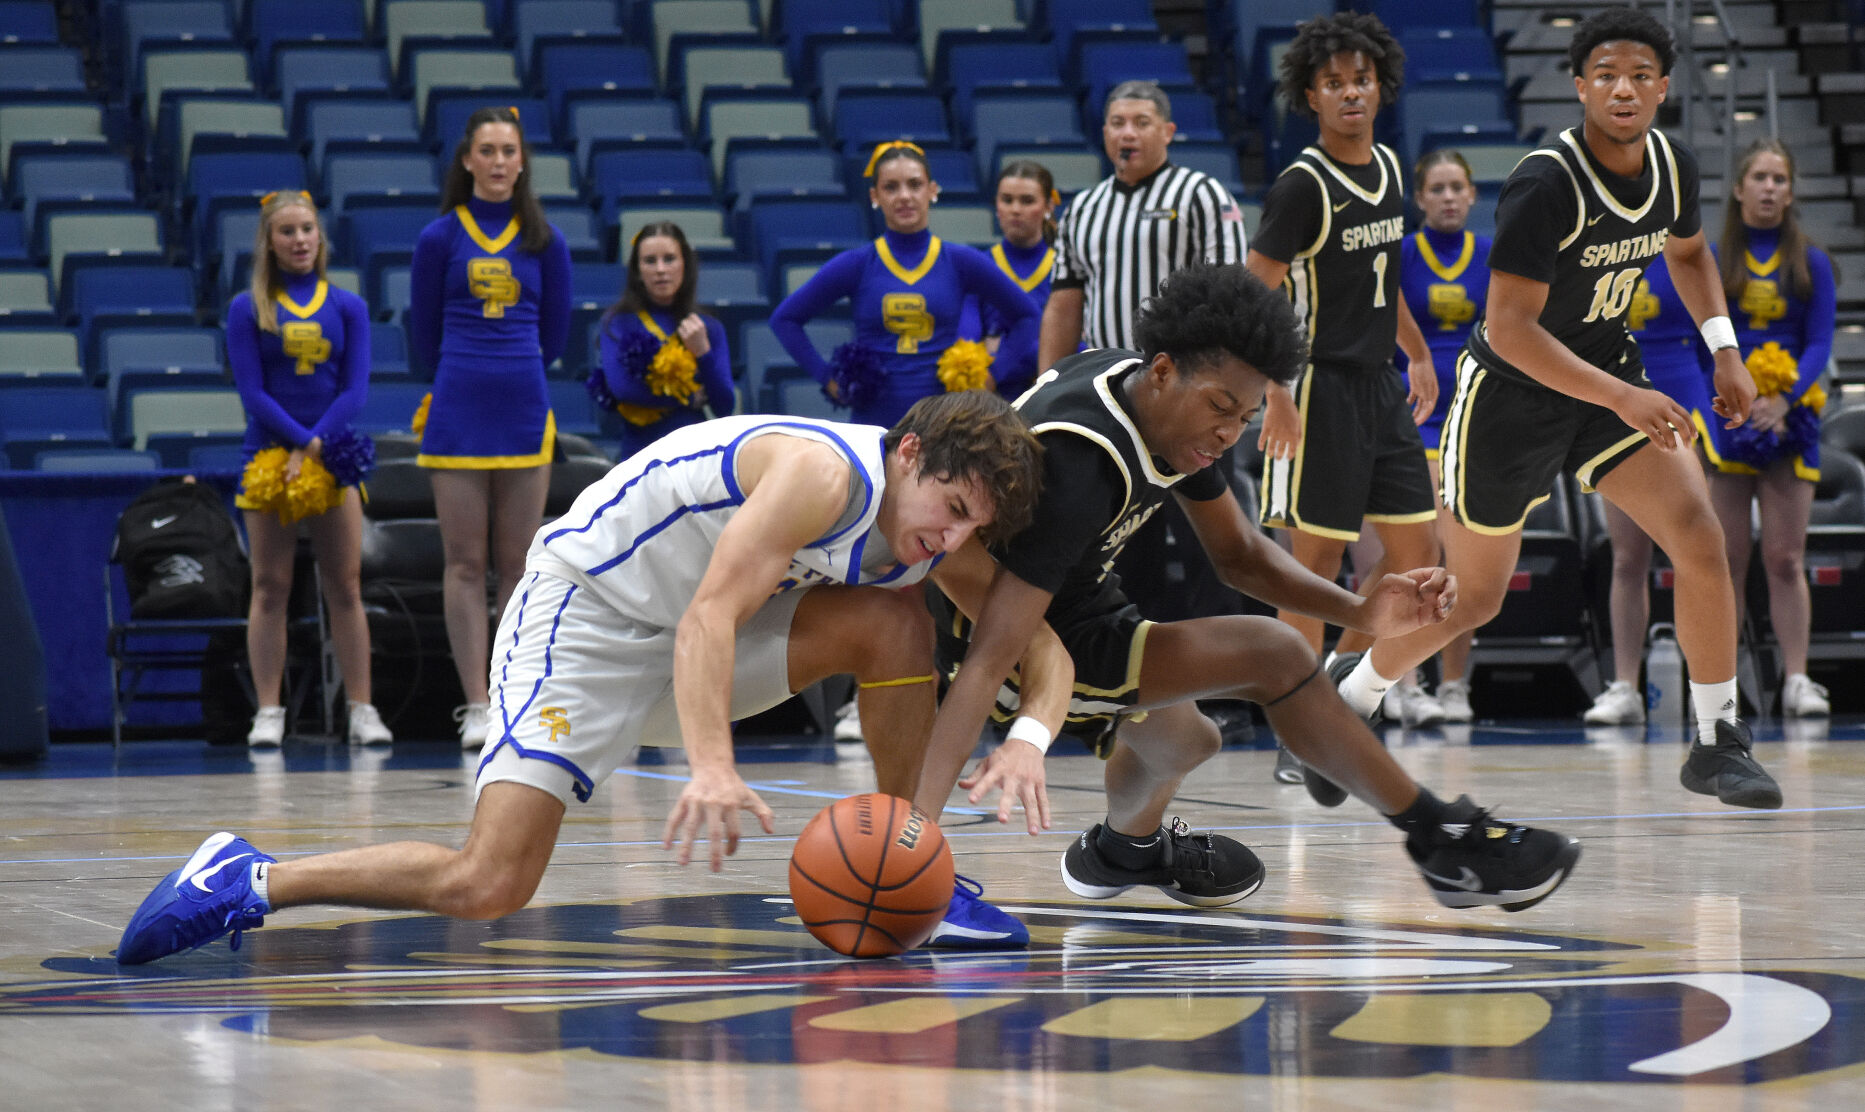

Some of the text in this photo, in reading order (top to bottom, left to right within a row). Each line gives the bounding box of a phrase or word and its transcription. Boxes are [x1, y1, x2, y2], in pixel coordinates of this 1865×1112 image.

[1580, 227, 1669, 267] SPARTANS
[1373, 252, 1388, 307] 1
[1582, 267, 1642, 323] 10
